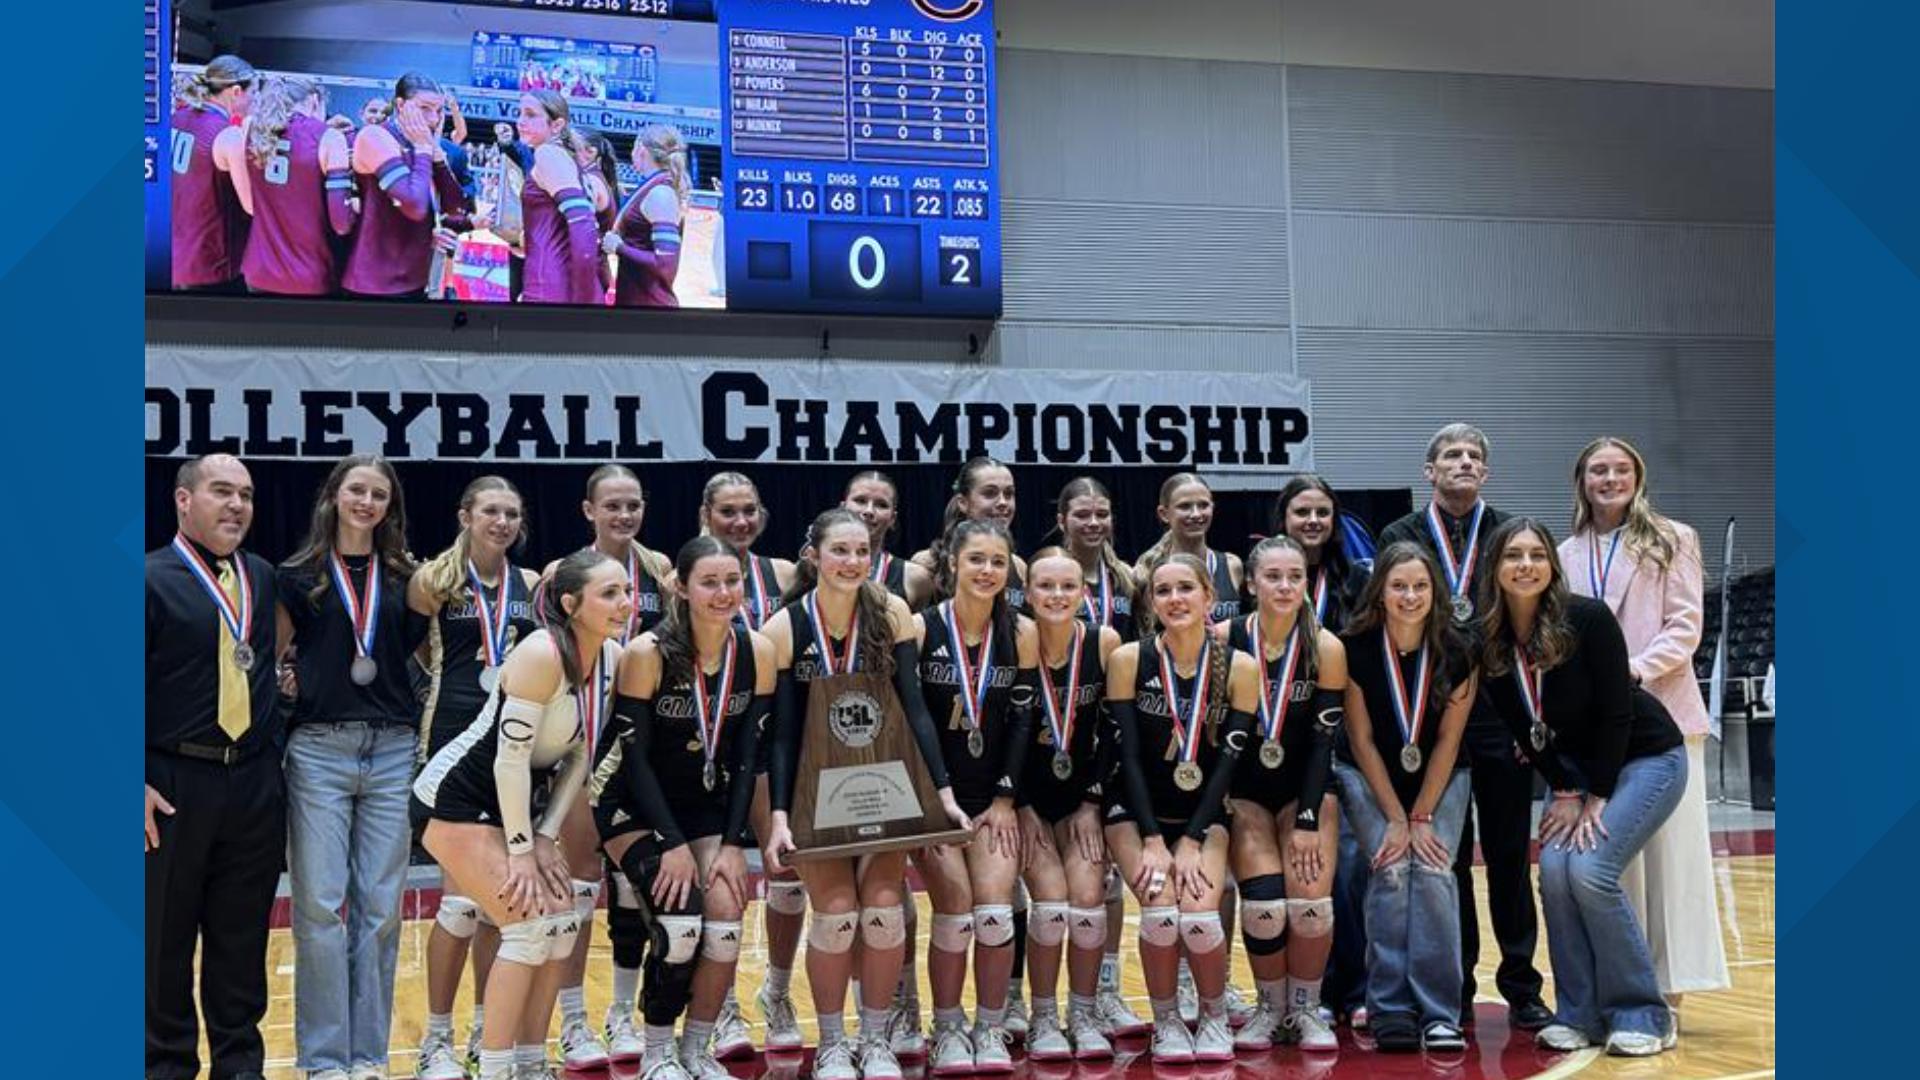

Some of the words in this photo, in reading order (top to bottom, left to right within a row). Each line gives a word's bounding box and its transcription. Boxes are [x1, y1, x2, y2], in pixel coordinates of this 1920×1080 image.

[629, 0, 667, 14] 25-12
[855, 26, 877, 40] KLS
[890, 28, 912, 41] BLK
[923, 30, 946, 43] DIG
[957, 33, 982, 46] ACE
[861, 42, 870, 55] 5
[896, 44, 907, 58] 0
[928, 46, 944, 60] 17
[964, 48, 975, 62] 0
[744, 56, 796, 72] ANDERSON
[861, 62, 871, 75] 0
[900, 64, 906, 77] 1
[929, 66, 944, 80] 12
[965, 68, 975, 81] 0
[745, 76, 785, 91] POWERS
[861, 83, 871, 97] 6
[898, 85, 907, 99] 0
[931, 87, 941, 100] 7
[965, 89, 975, 103] 0
[865, 103, 871, 117] 1
[901, 105, 907, 119] 1
[932, 107, 942, 121] 2
[965, 109, 975, 123] 0
[861, 124, 871, 138] 0
[898, 126, 908, 139] 0
[933, 127, 942, 141] 8
[969, 129, 976, 142] 1
[264, 139, 291, 184] 6
[737, 169, 769, 181] KILLS
[784, 170, 812, 183] BLKS
[827, 173, 857, 185] DIGS
[870, 175, 900, 188] ACES
[913, 177, 941, 190] ASTS
[953, 178, 977, 191] ATK
[979, 180, 989, 192] %
[742, 188, 767, 207] 23
[786, 190, 815, 209] 1.0
[831, 192, 855, 211] 68
[884, 194, 891, 213] 1
[917, 195, 940, 215] 22
[954, 198, 983, 216] .085
[850, 235, 886, 289] 0
[951, 254, 970, 283] 2
[701, 371, 1309, 465] CHAMPIONSHIP
